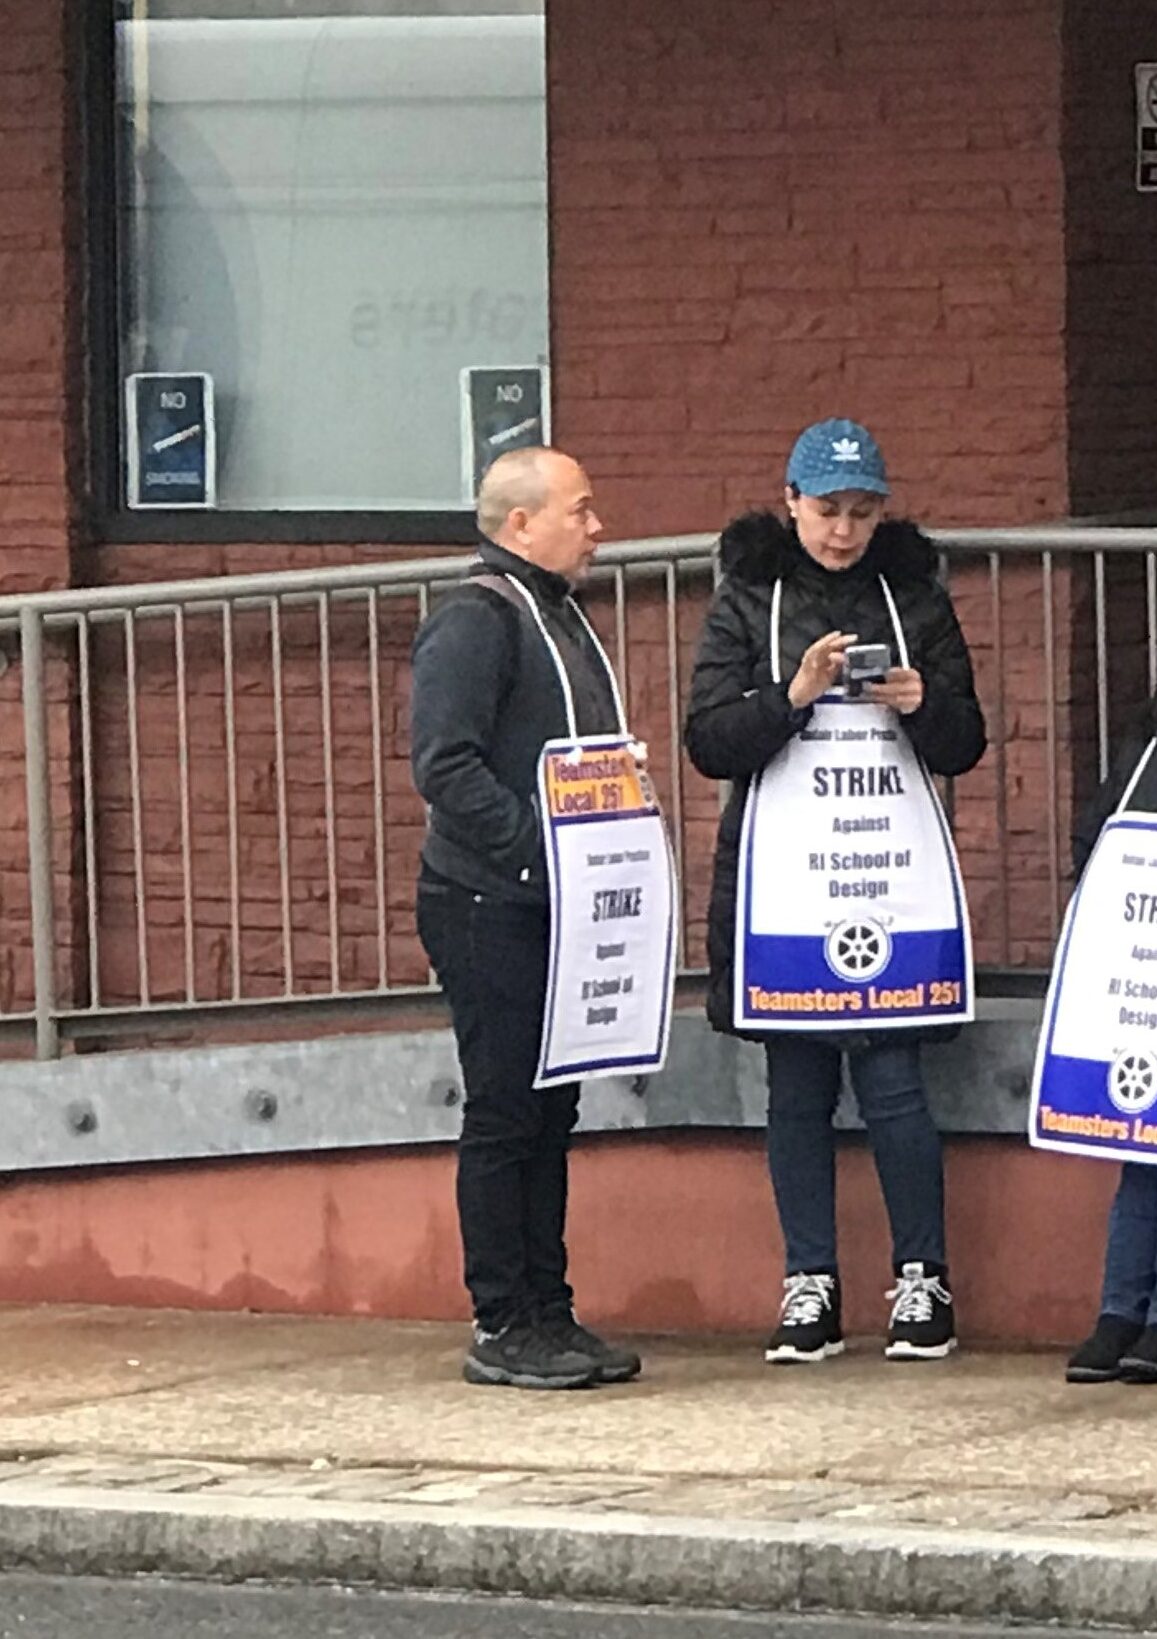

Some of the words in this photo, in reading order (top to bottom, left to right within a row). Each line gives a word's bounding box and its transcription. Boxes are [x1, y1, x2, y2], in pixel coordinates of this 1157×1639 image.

[161, 391, 186, 409] NO
[496, 384, 523, 403] NO
[835, 728, 868, 741] Labor
[552, 754, 629, 783] Teamster
[554, 784, 597, 812] Local
[601, 783, 623, 810] 251
[832, 815, 890, 834] Against
[809, 853, 825, 870] RI
[830, 850, 890, 870] School
[894, 848, 911, 868] of
[829, 877, 889, 899] Design
[592, 886, 642, 922] STRIKE
[748, 987, 863, 1012] Teamsters
[868, 983, 924, 1010] Local
[929, 981, 960, 1005] 251
[1108, 978, 1121, 995] RI
[1041, 1105, 1129, 1140] Teamsters
